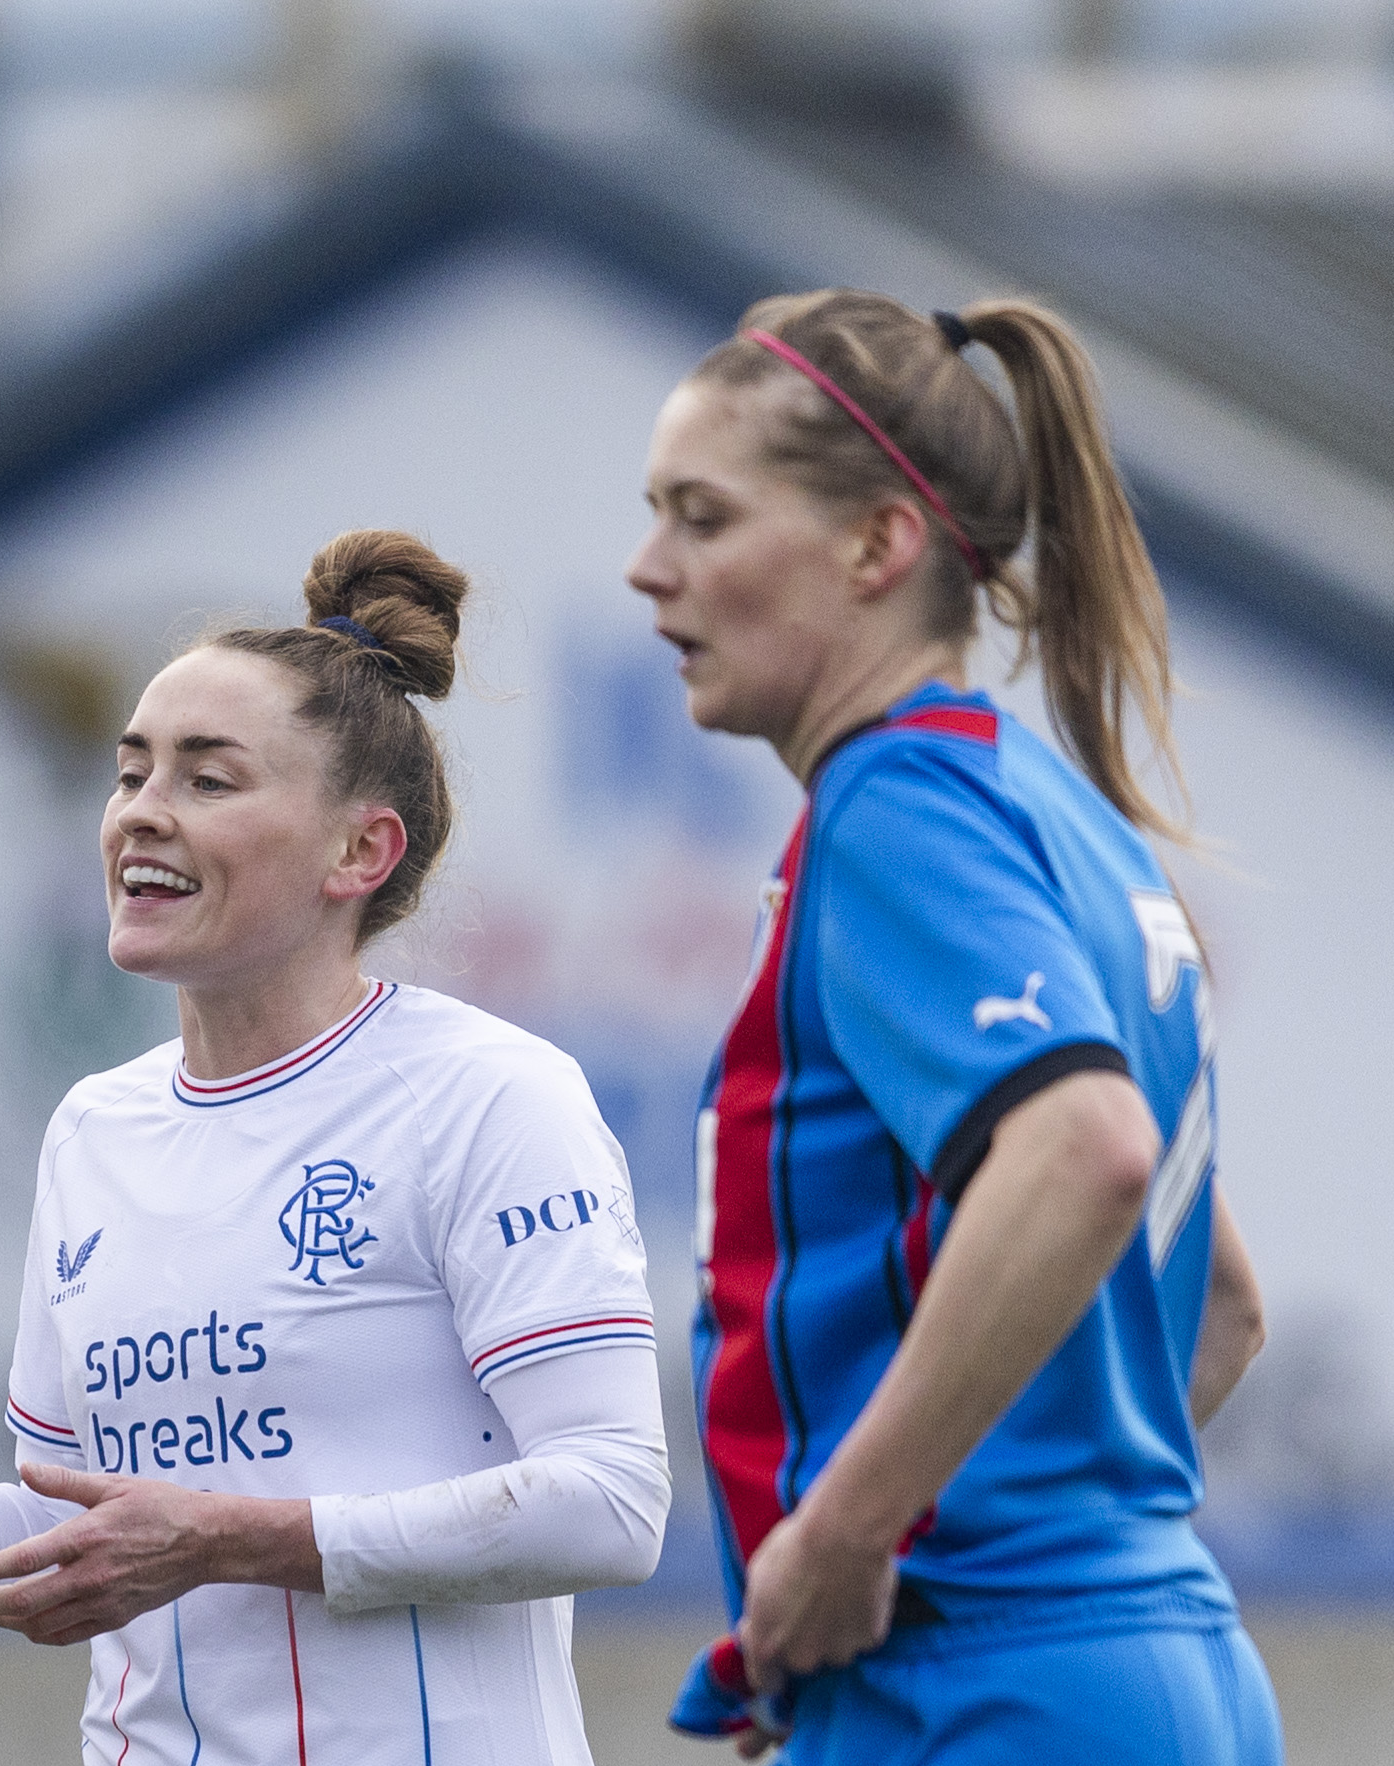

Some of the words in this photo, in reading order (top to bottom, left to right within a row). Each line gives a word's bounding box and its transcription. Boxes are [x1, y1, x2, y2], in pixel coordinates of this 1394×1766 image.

[495, 1188, 599, 1248] DCP
[85, 1309, 267, 1400] sports
[91, 1395, 294, 1474] breaks
